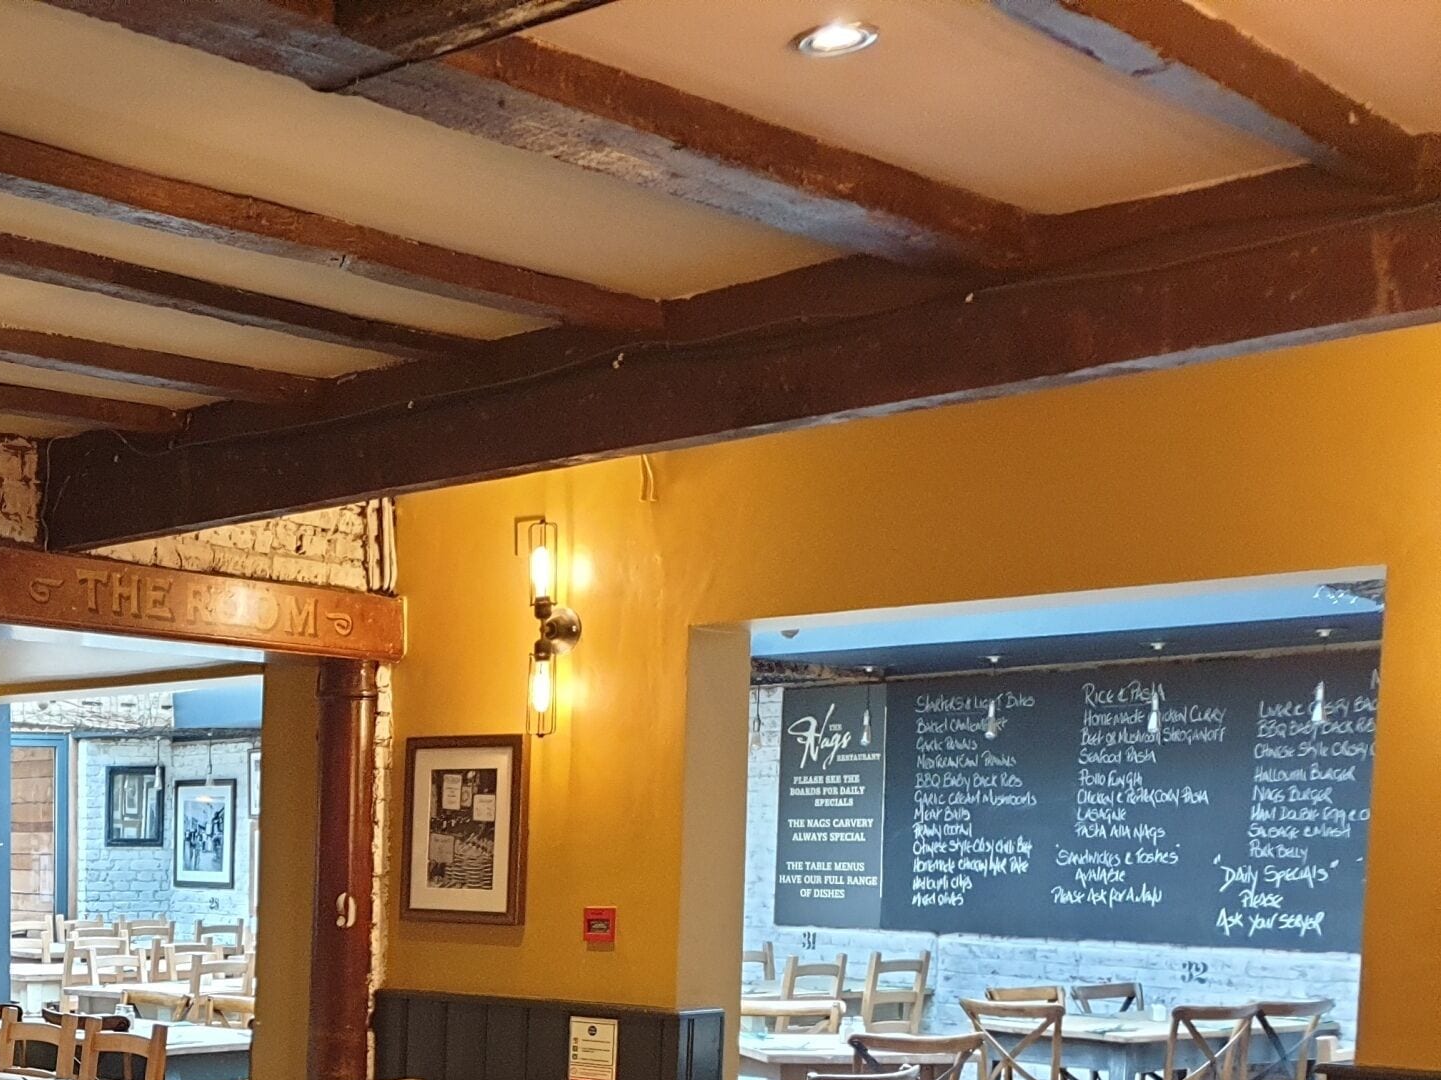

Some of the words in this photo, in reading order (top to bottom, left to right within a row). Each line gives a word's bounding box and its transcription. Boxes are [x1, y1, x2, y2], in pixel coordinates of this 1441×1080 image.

[75, 567, 175, 623] THE
[186, 582, 320, 640] ROOM
[787, 702, 853, 771] Nags
[836, 753, 882, 762] RESTAURANT
[793, 775, 824, 785] PLEASE
[825, 775, 842, 784] SEE
[843, 774, 861, 784] THE
[790, 787, 821, 796] BOARDS
[822, 786, 839, 796] FOR
[840, 785, 866, 795] DAILY
[814, 798, 854, 808] SPECIALS
[788, 819, 806, 828] THE
[807, 819, 831, 828] NAGS
[832, 818, 874, 828] CARVERY
[792, 832, 828, 842] ALWAYS
[829, 832, 866, 842] SPECIAL
[786, 861, 804, 871] THE
[805, 861, 832, 871] TABLE
[834, 862, 865, 871] MENUS
[779, 875, 802, 884] HAVE
[803, 875, 822, 885] OUR
[823, 876, 845, 885] FULL
[847, 876, 878, 886] RANGE
[800, 888, 812, 898] OF
[813, 889, 846, 898] DISHES
[335, 892, 357, 928] 9
